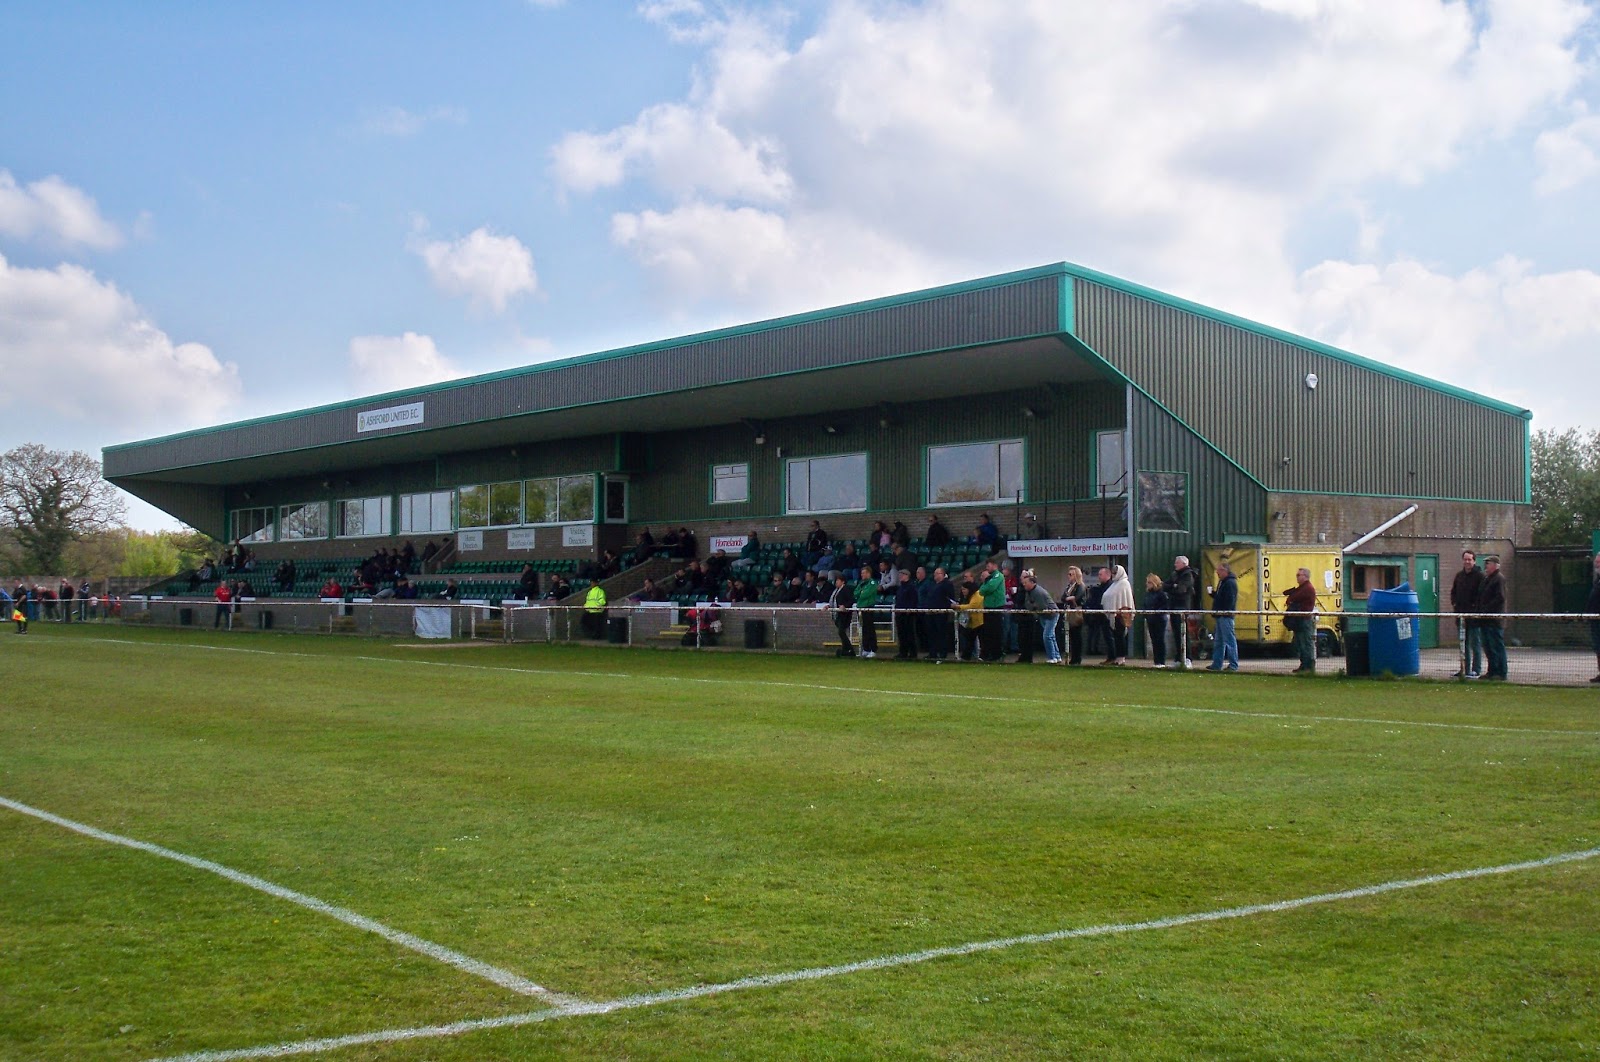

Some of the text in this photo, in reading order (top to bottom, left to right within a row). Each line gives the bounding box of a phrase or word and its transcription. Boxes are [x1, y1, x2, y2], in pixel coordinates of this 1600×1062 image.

[366, 413, 389, 426] ASHFORD
[390, 410, 409, 421] UNITED
[716, 538, 742, 547] Homelands
[1072, 544, 1091, 553] Burger
